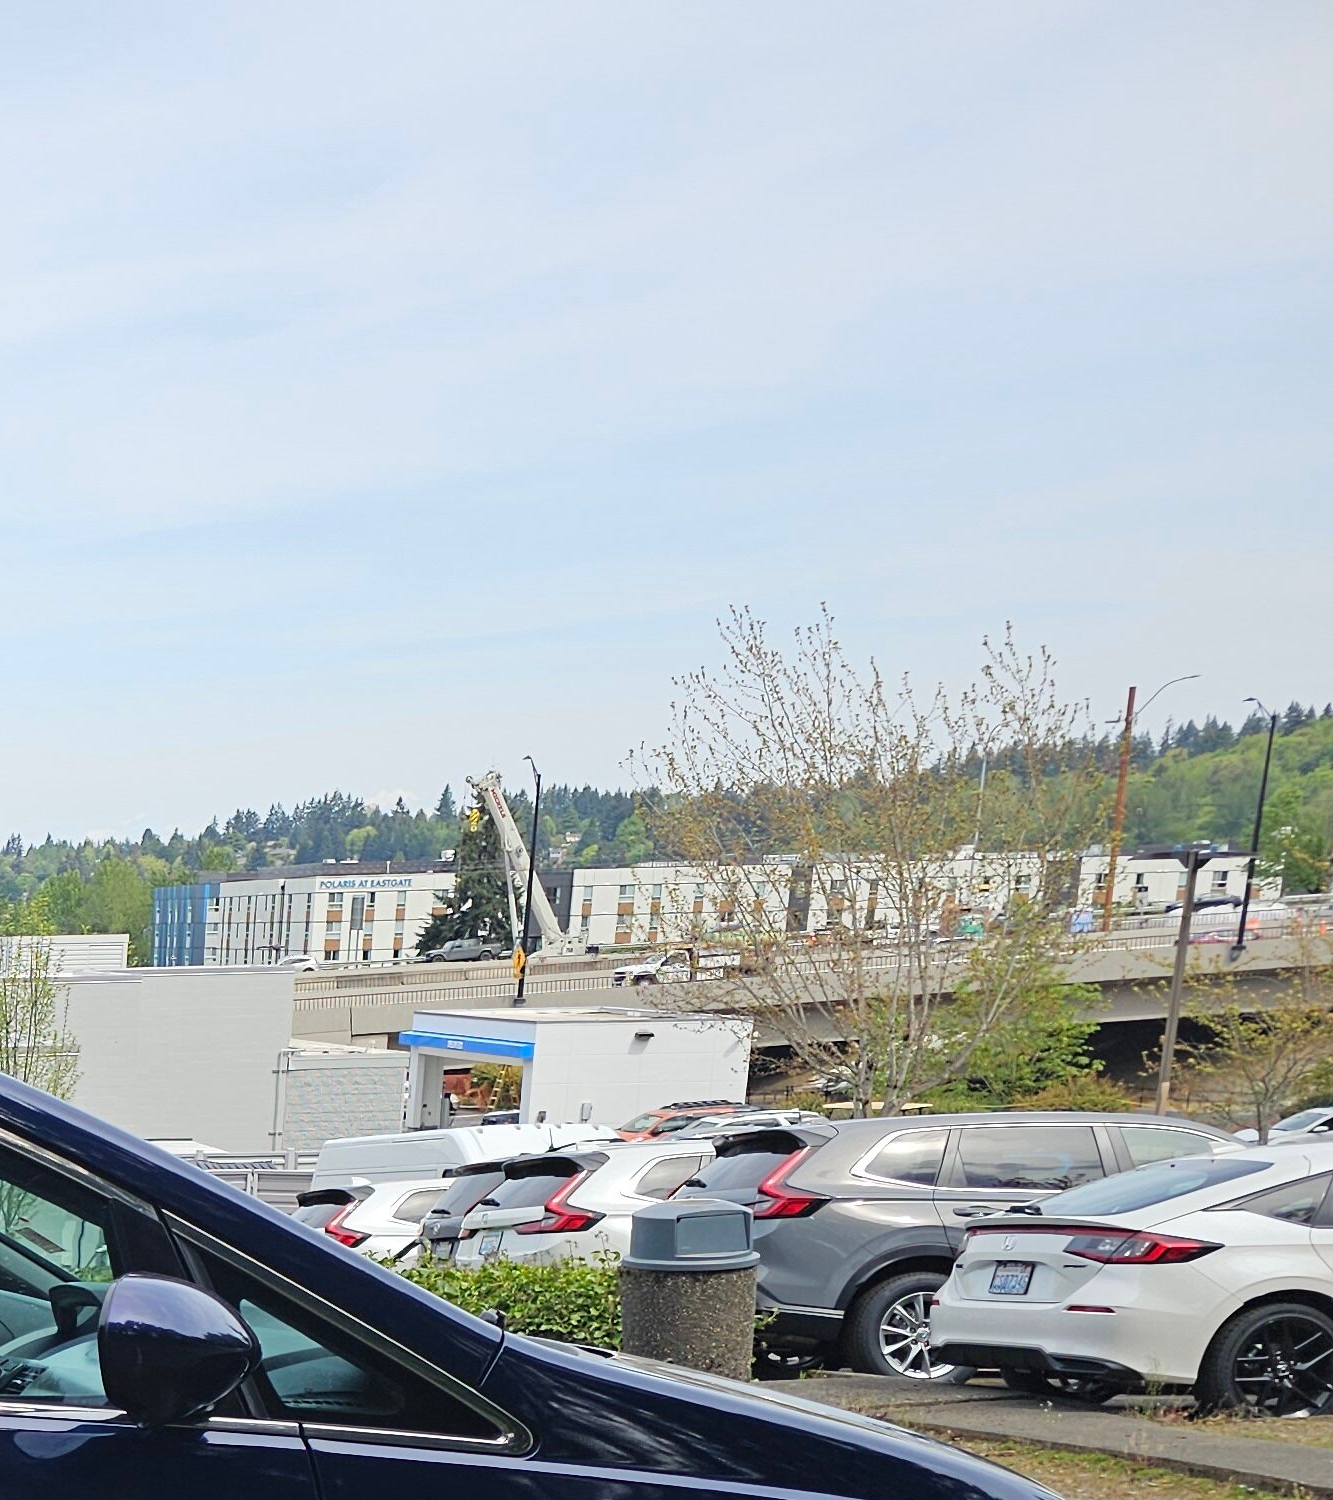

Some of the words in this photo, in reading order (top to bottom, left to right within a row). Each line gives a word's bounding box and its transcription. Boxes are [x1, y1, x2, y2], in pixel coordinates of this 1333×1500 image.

[319, 880, 356, 889] POLARIS
[358, 880, 369, 888] AT
[370, 878, 412, 888] EASTGATE
